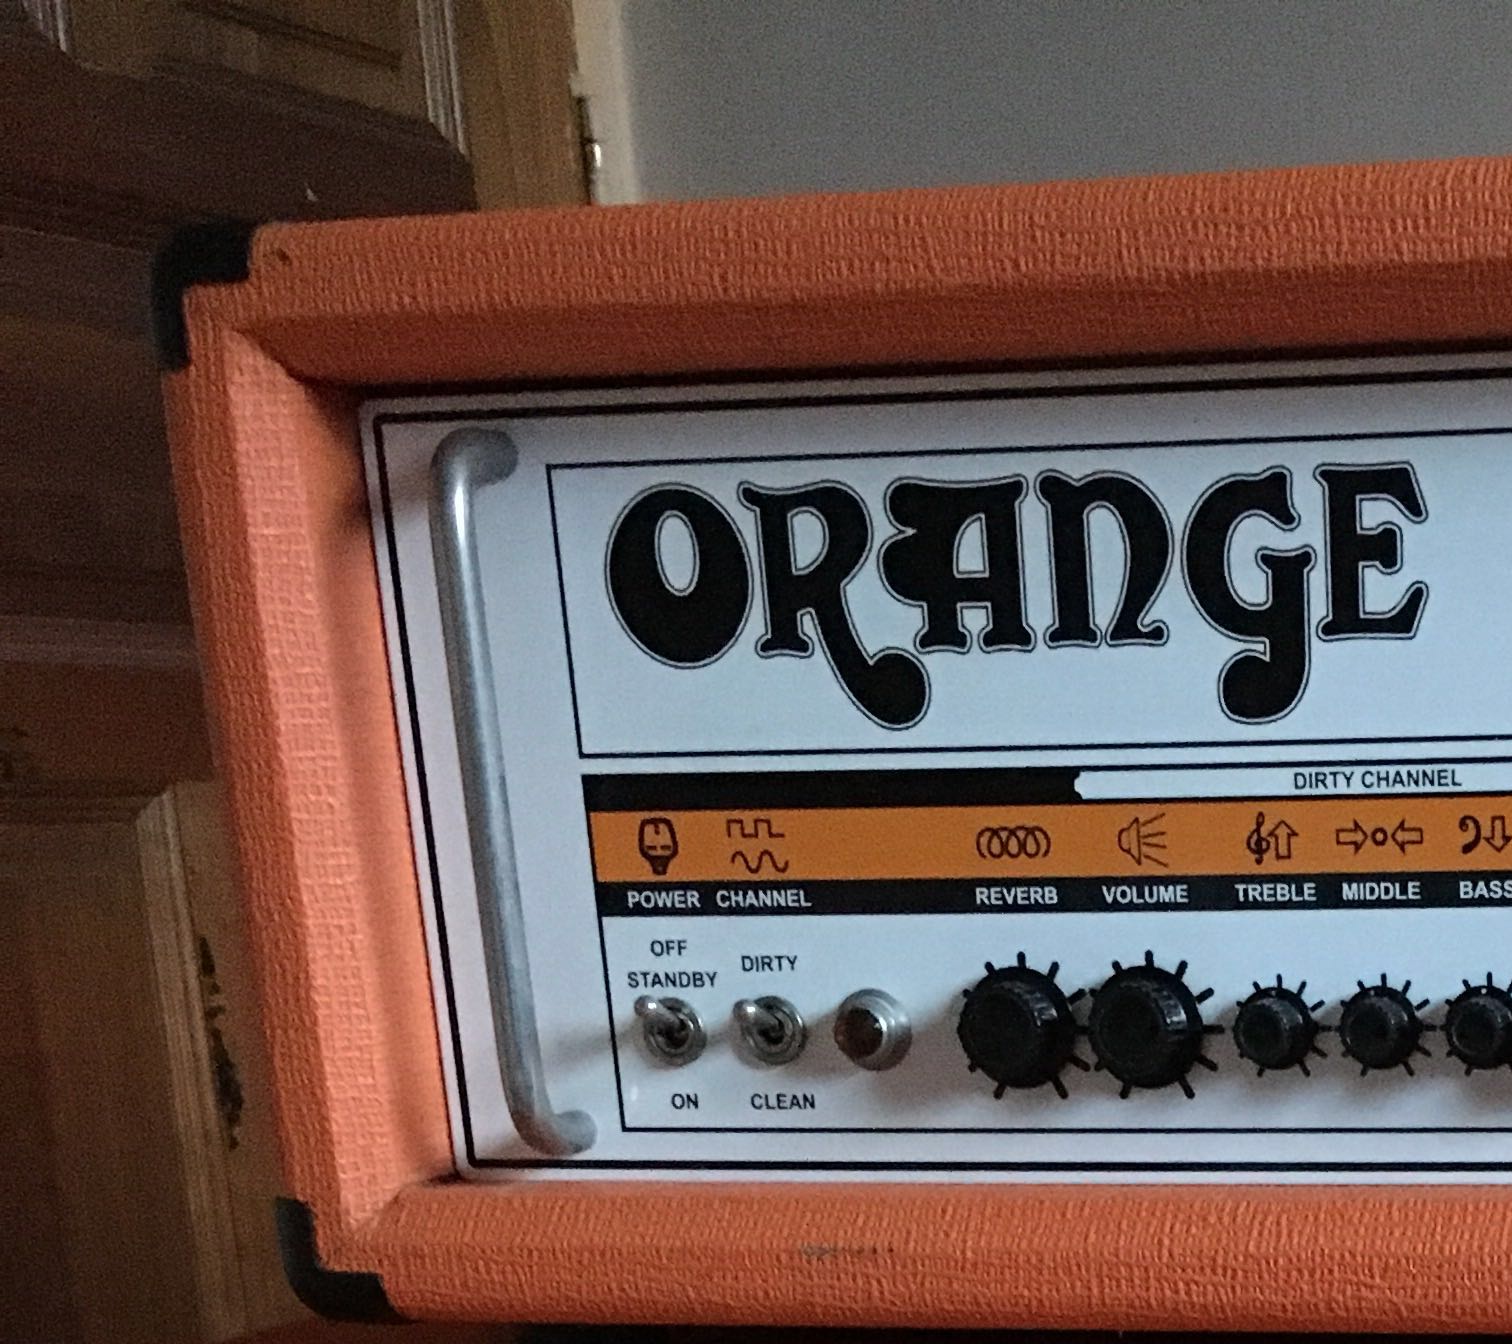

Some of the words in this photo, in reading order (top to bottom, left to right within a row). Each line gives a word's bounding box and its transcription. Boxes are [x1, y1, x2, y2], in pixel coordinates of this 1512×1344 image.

[605, 460, 1430, 731] ORANGE
[1293, 771, 1353, 791] DIRTY
[1361, 767, 1463, 789] CHANNEL
[627, 890, 701, 909] POWER
[716, 889, 812, 908] CHANNEL
[975, 886, 1058, 905] REVERB
[1101, 884, 1189, 904] VOLUME
[1234, 882, 1317, 902] TREBLE
[1341, 881, 1421, 901] MIDDLE
[650, 939, 687, 957] OFF
[741, 954, 798, 973] DIRTY
[627, 970, 718, 989] STANDBY
[671, 1093, 699, 1110] ON
[750, 1093, 816, 1110] CLEAN
